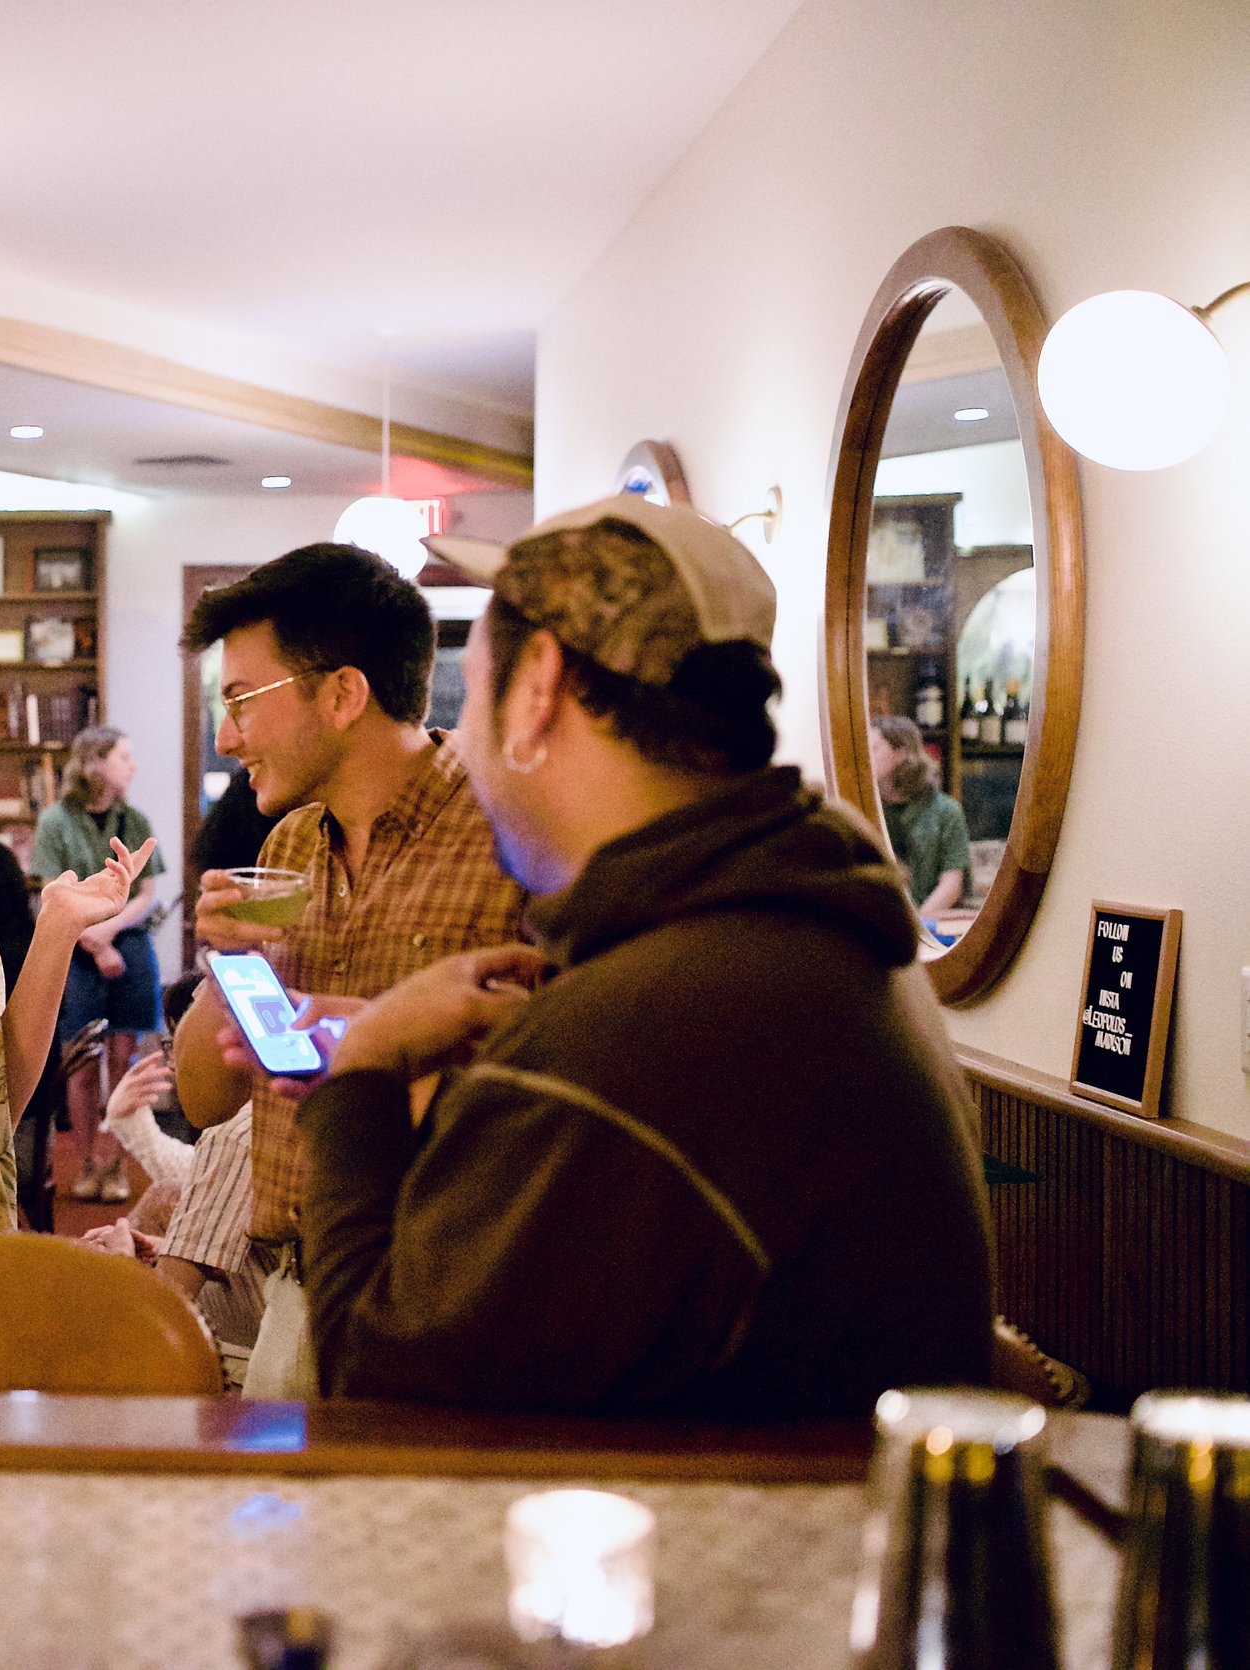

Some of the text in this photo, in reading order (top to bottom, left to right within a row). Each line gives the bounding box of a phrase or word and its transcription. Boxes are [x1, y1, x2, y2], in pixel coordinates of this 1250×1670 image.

[1097, 920, 1130, 941] FOLLOW
[1112, 946, 1124, 963] US
[1120, 971, 1133, 989] ON
